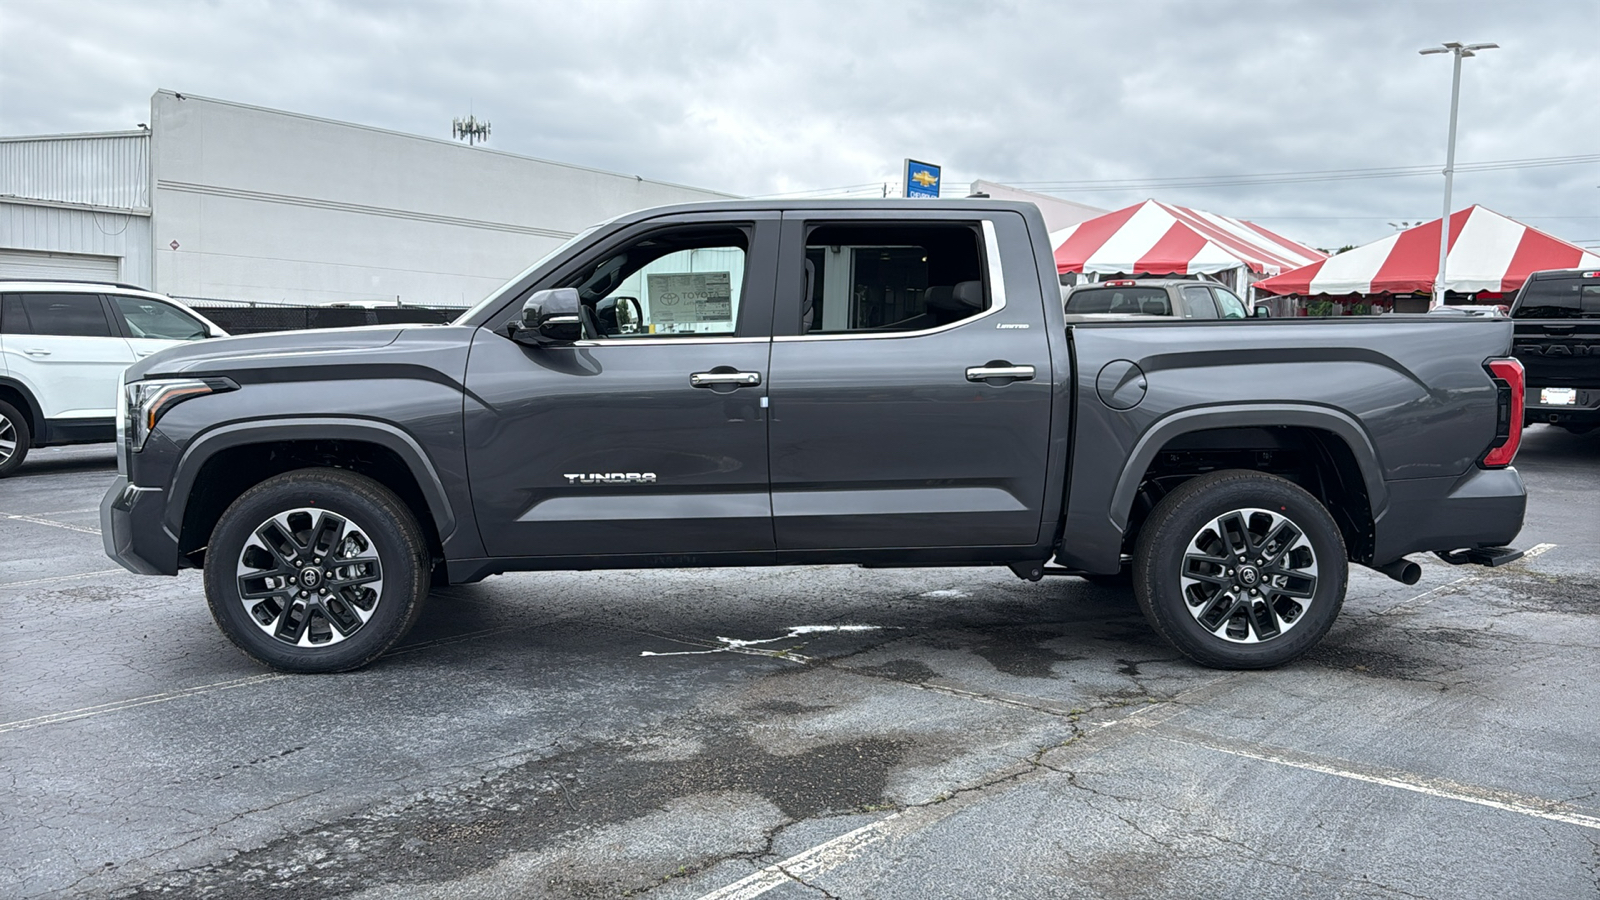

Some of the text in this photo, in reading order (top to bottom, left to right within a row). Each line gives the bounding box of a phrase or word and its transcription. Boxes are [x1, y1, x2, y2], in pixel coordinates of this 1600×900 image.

[910, 190, 939, 199] CHEVROL
[681, 291, 720, 300] TOYOTA
[1516, 344, 1600, 355] RAM
[563, 472, 657, 484] TUNDRA
